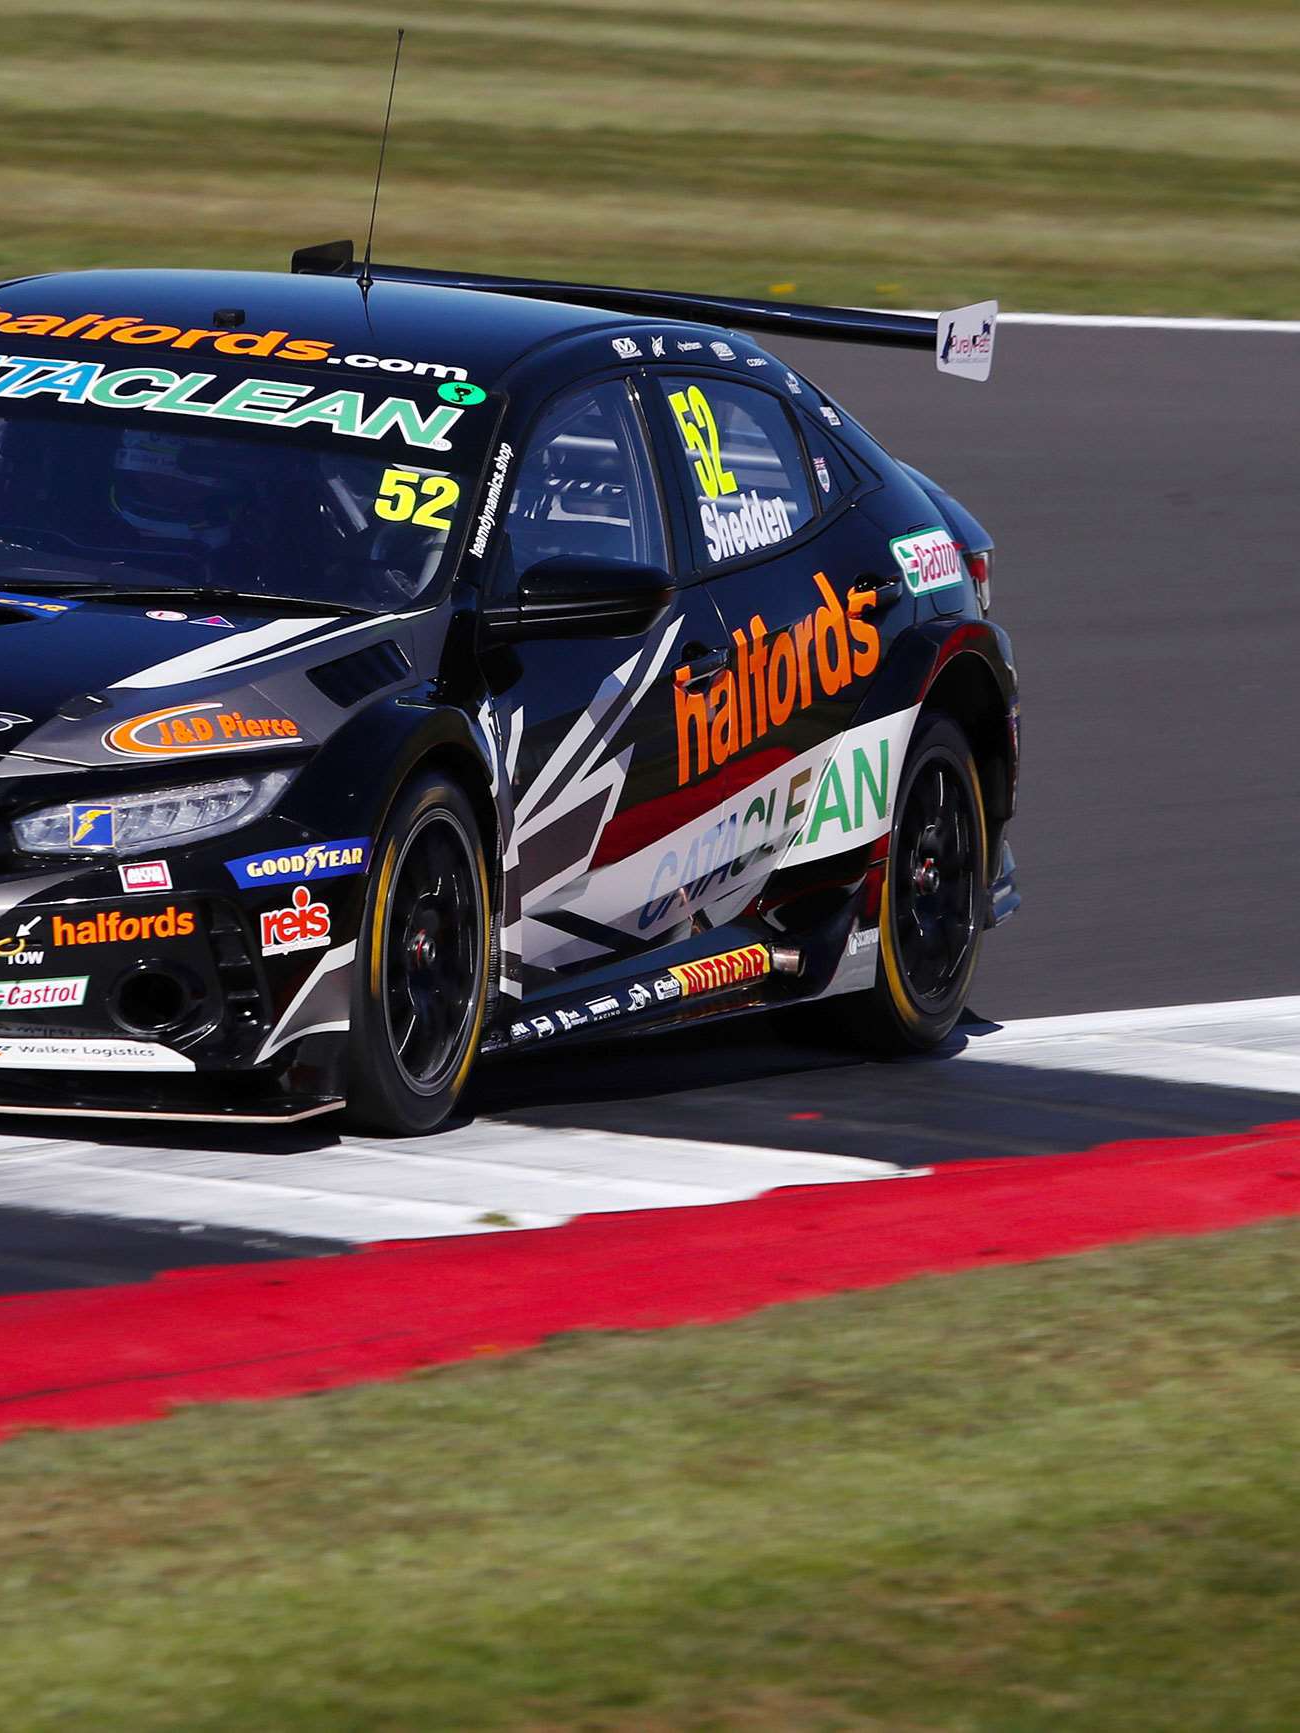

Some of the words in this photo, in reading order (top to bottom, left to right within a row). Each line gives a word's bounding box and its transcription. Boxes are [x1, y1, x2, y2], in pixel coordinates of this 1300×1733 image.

[668, 385, 738, 500] 52
[374, 469, 460, 530] 52
[470, 442, 511, 559] teamdynamics.shop
[700, 490, 793, 562] Shedden
[674, 571, 880, 786] halfords
[158, 717, 214, 746] J&D
[218, 713, 299, 740] Pierce
[52, 906, 195, 947] halfords
[262, 887, 330, 946] reis
[7, 983, 79, 1006] Castrol
[680, 948, 765, 994] AUTOCAR
[18, 1045, 76, 1054] Walker
[83, 1046, 156, 1057] Logistics
